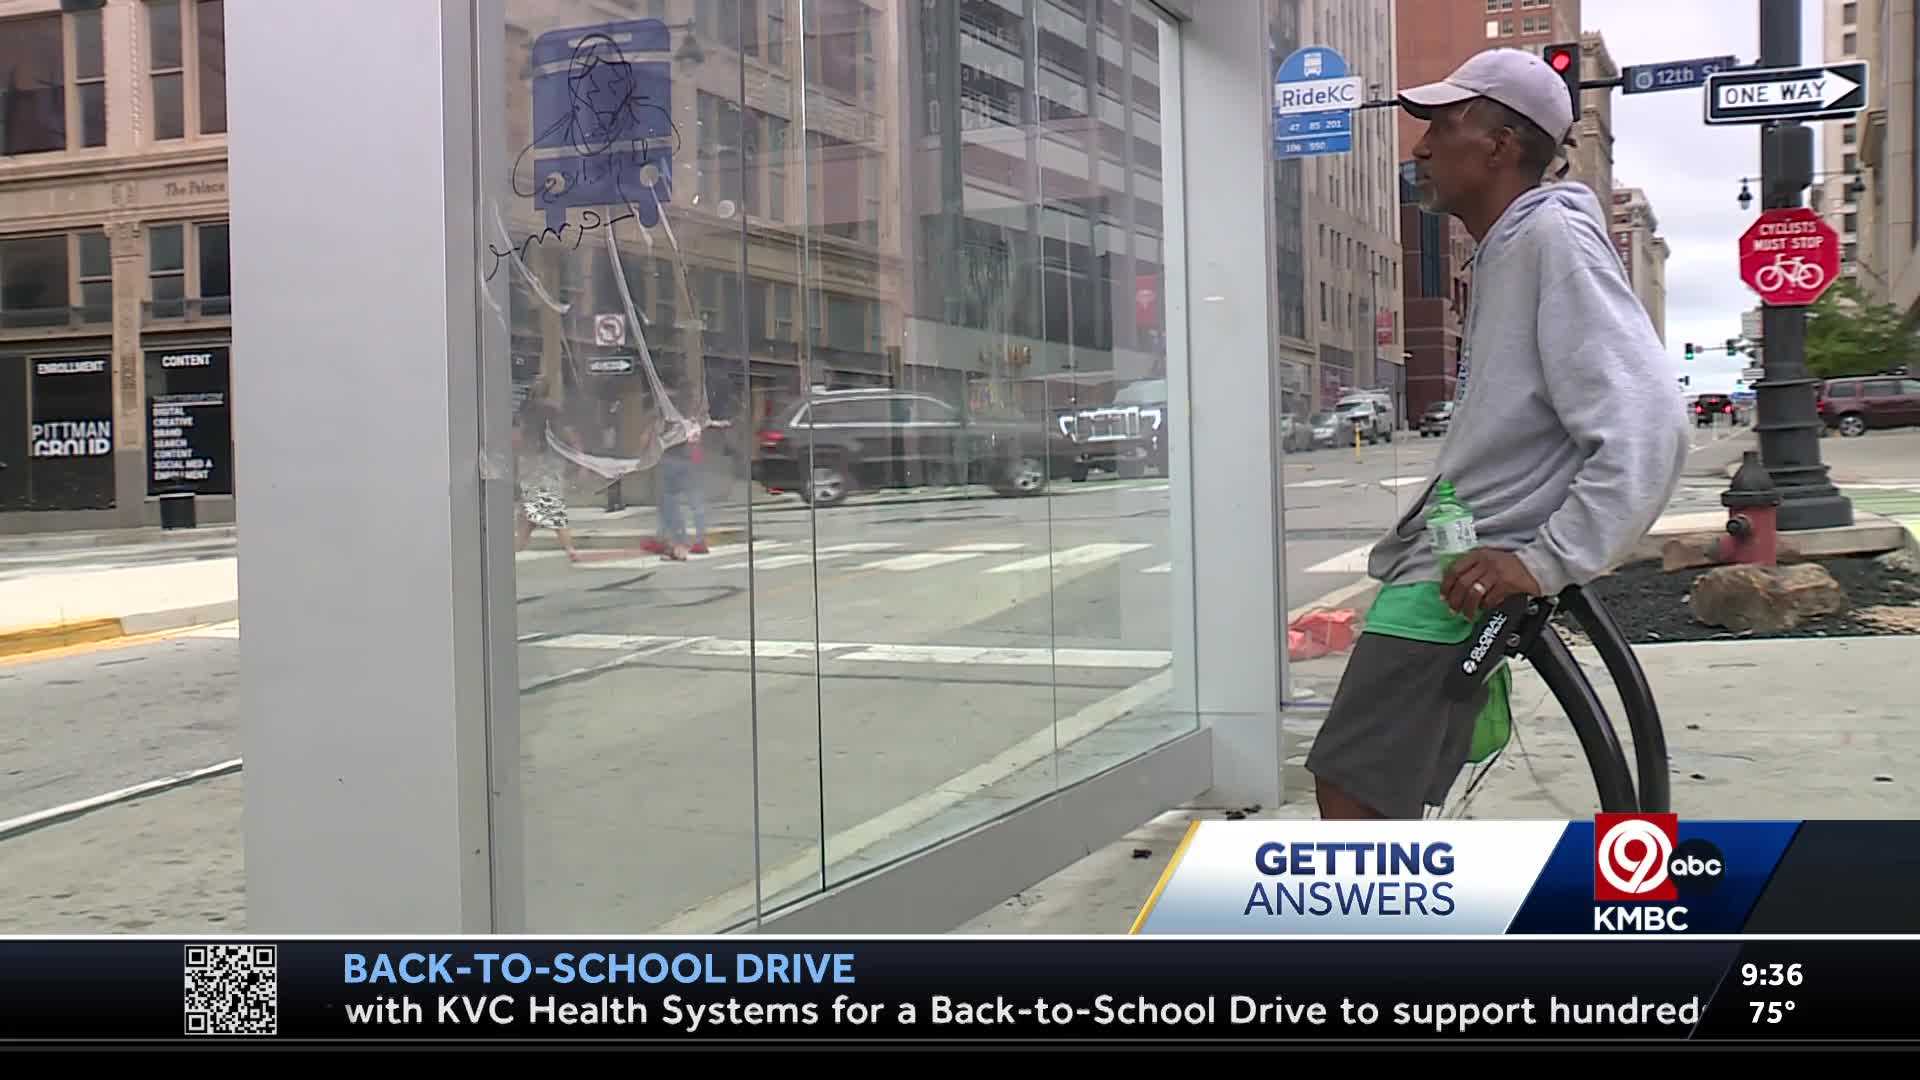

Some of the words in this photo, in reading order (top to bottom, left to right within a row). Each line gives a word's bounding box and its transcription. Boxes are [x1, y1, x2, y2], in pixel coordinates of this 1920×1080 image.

[1656, 67, 1694, 85] 12th
[1702, 64, 1721, 79] St
[1282, 83, 1354, 107] RideKC
[1725, 87, 1769, 105] ONE
[1780, 81, 1827, 102] WAY
[1759, 221, 1817, 236] CYCLISTS
[1753, 238, 1785, 252] MUST
[1792, 236, 1824, 250] STOP
[37, 360, 104, 375] ENROLLMENT
[162, 354, 212, 368] CONTENT
[153, 417, 193, 428] CREATIVE
[32, 421, 111, 442] PITTMAN
[154, 449, 193, 459] CONTENT
[185, 458, 213, 469] MEDA
[1470, 610, 1504, 660] GLOBAL
